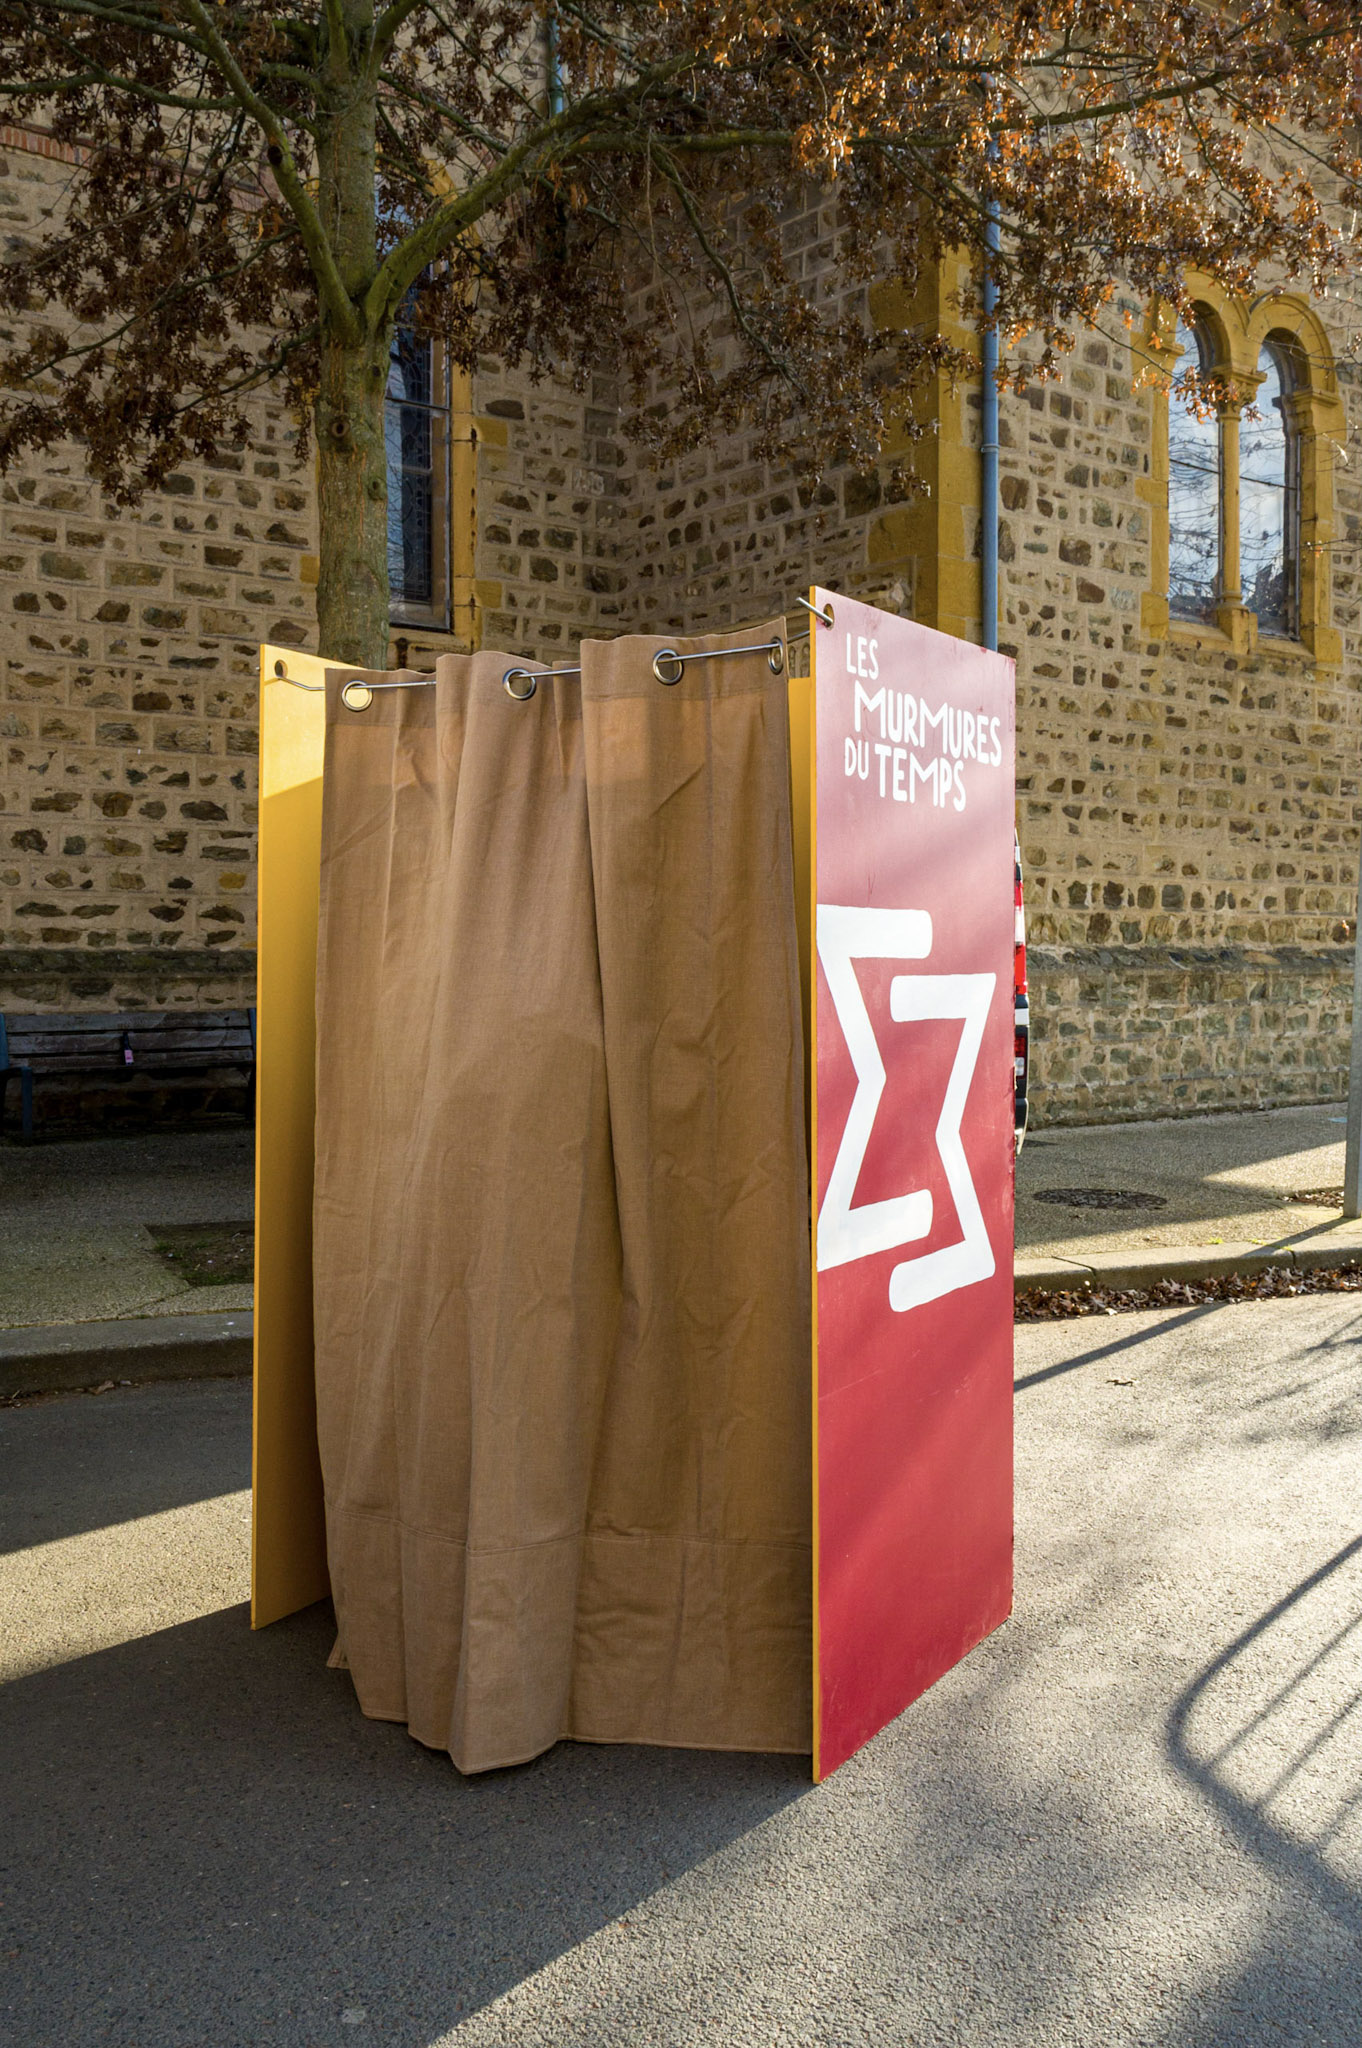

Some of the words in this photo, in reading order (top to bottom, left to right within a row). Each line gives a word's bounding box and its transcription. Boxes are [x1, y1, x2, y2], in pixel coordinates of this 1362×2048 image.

[846, 633, 879, 680] LES
[854, 680, 1002, 767] MURMURES
[844, 737, 869, 780] DU
[874, 743, 966, 812] TEMPS
